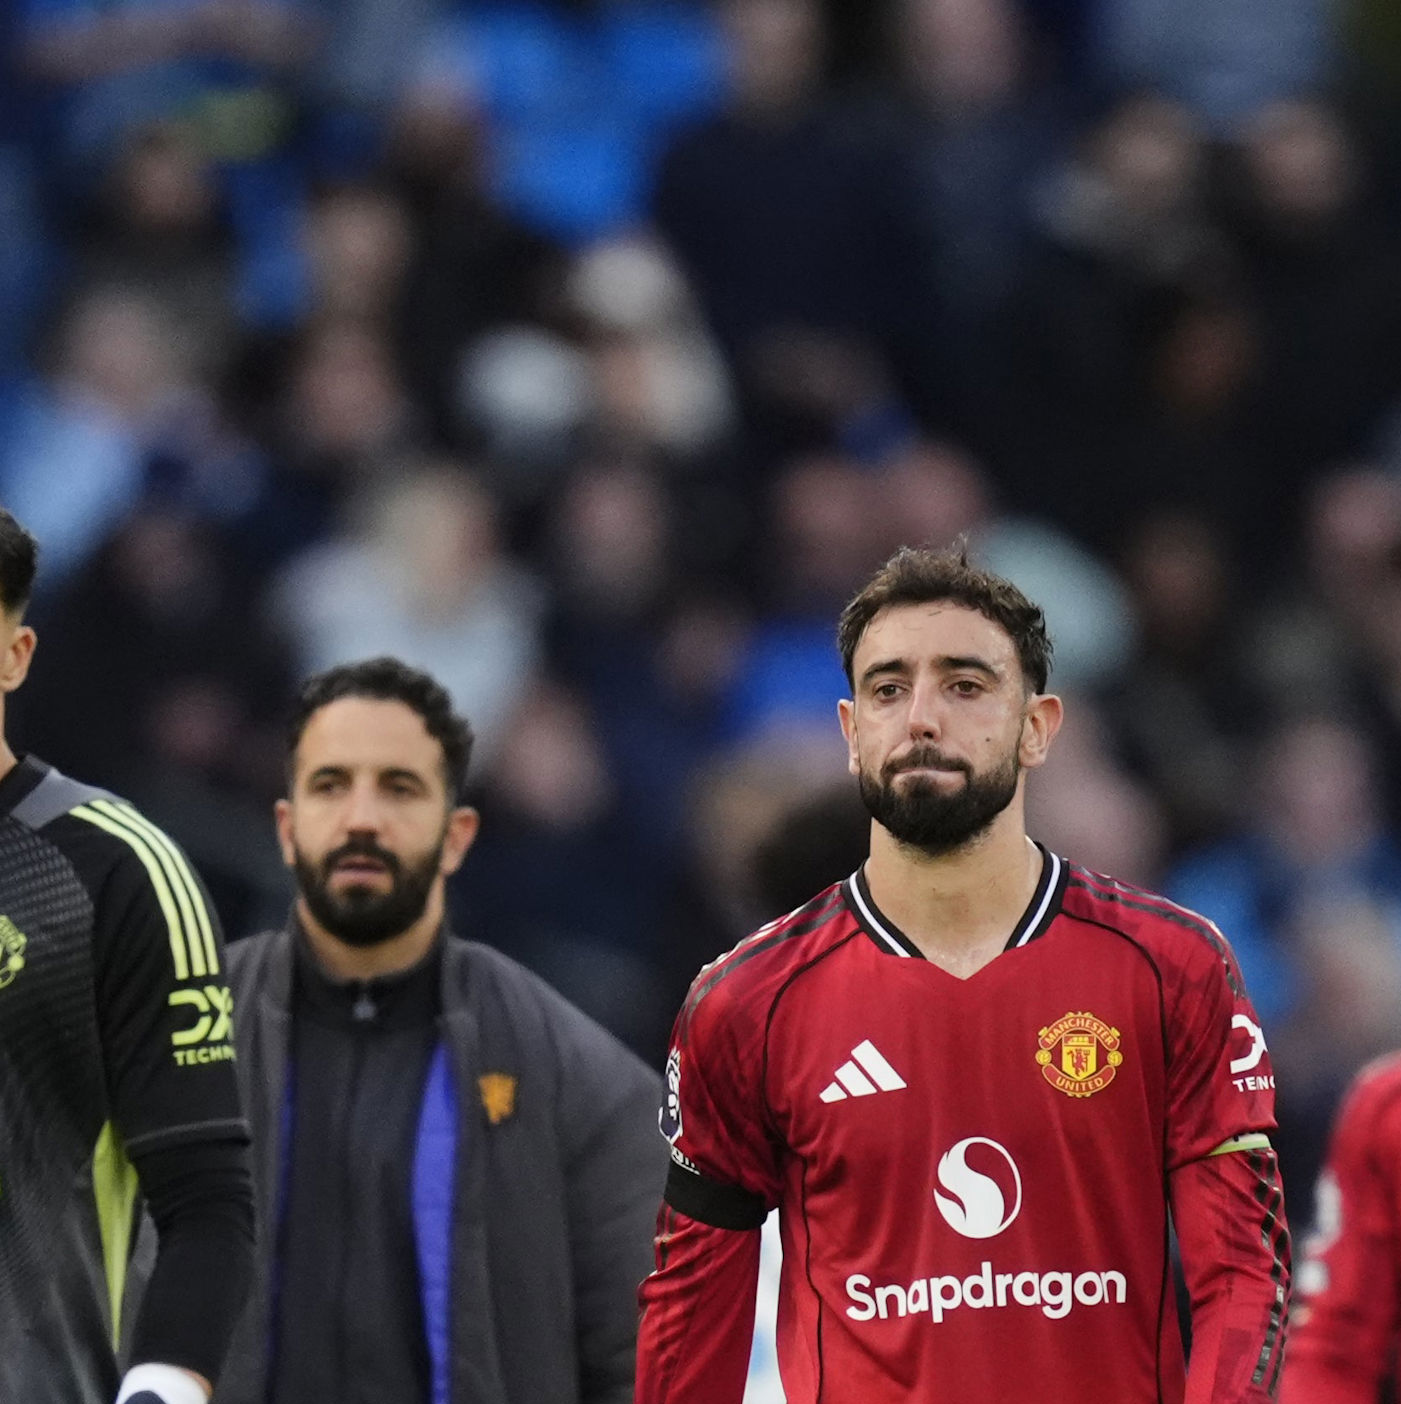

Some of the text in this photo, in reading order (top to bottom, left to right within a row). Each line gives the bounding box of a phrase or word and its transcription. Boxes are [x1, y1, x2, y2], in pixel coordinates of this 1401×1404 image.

[1044, 1018, 1116, 1046] MANCHESTER
[1055, 1077, 1104, 1092] UNITED
[845, 1261, 1127, 1324] Snapdragon
